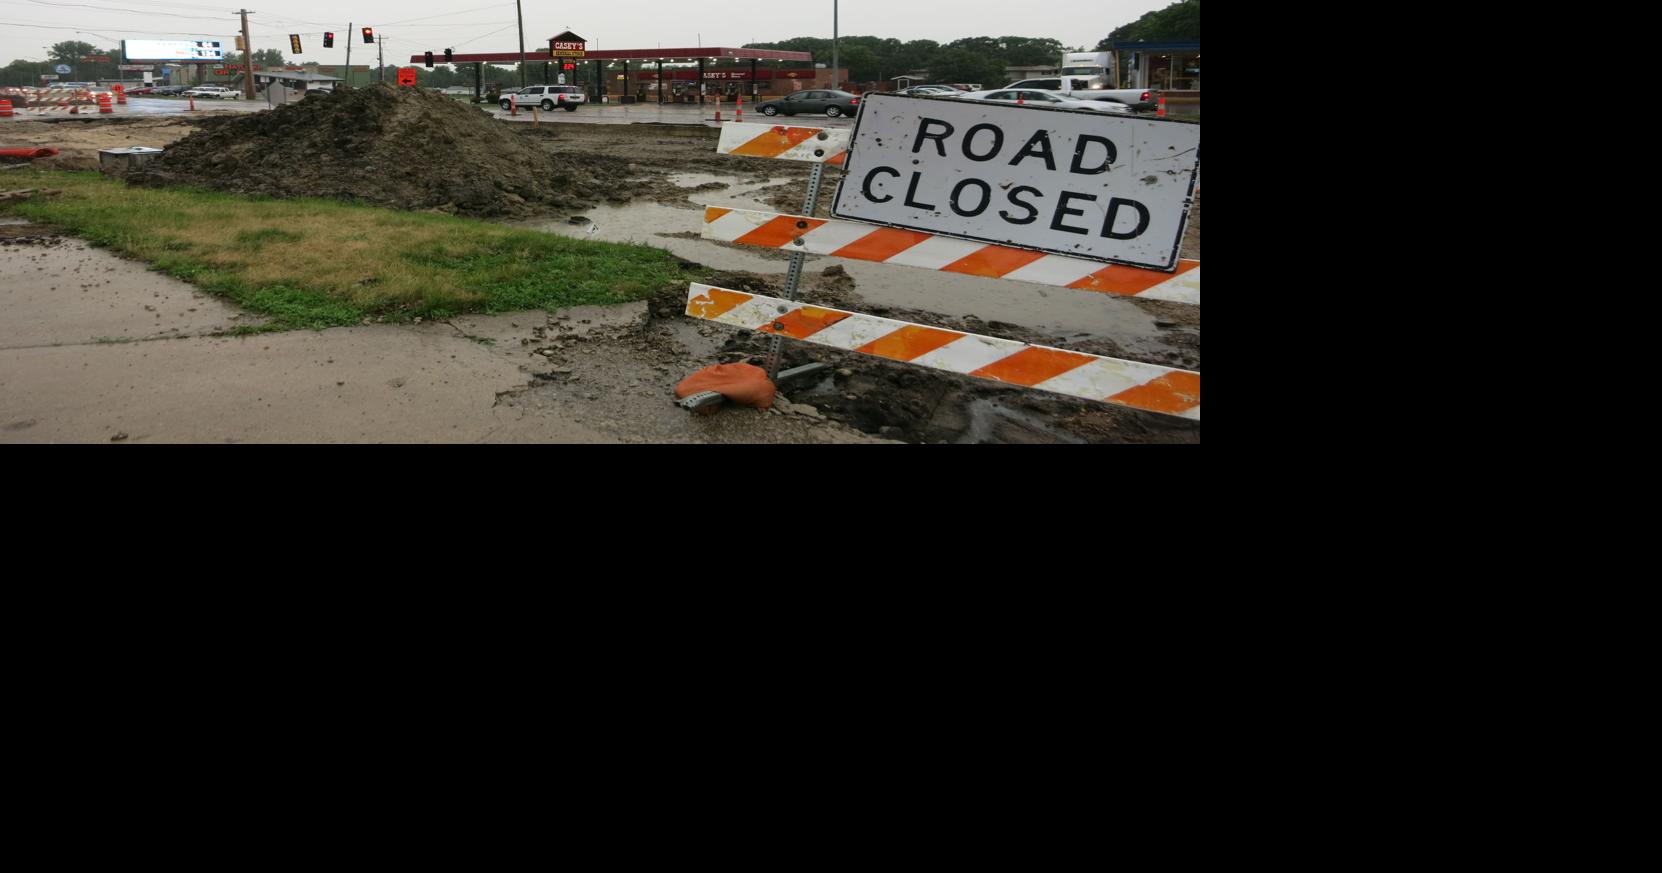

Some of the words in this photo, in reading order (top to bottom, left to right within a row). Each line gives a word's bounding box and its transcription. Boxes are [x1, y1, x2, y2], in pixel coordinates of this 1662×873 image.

[554, 42, 584, 50] CASEY'S
[911, 117, 1118, 175] ROAD
[861, 165, 1151, 241] CLOSED
